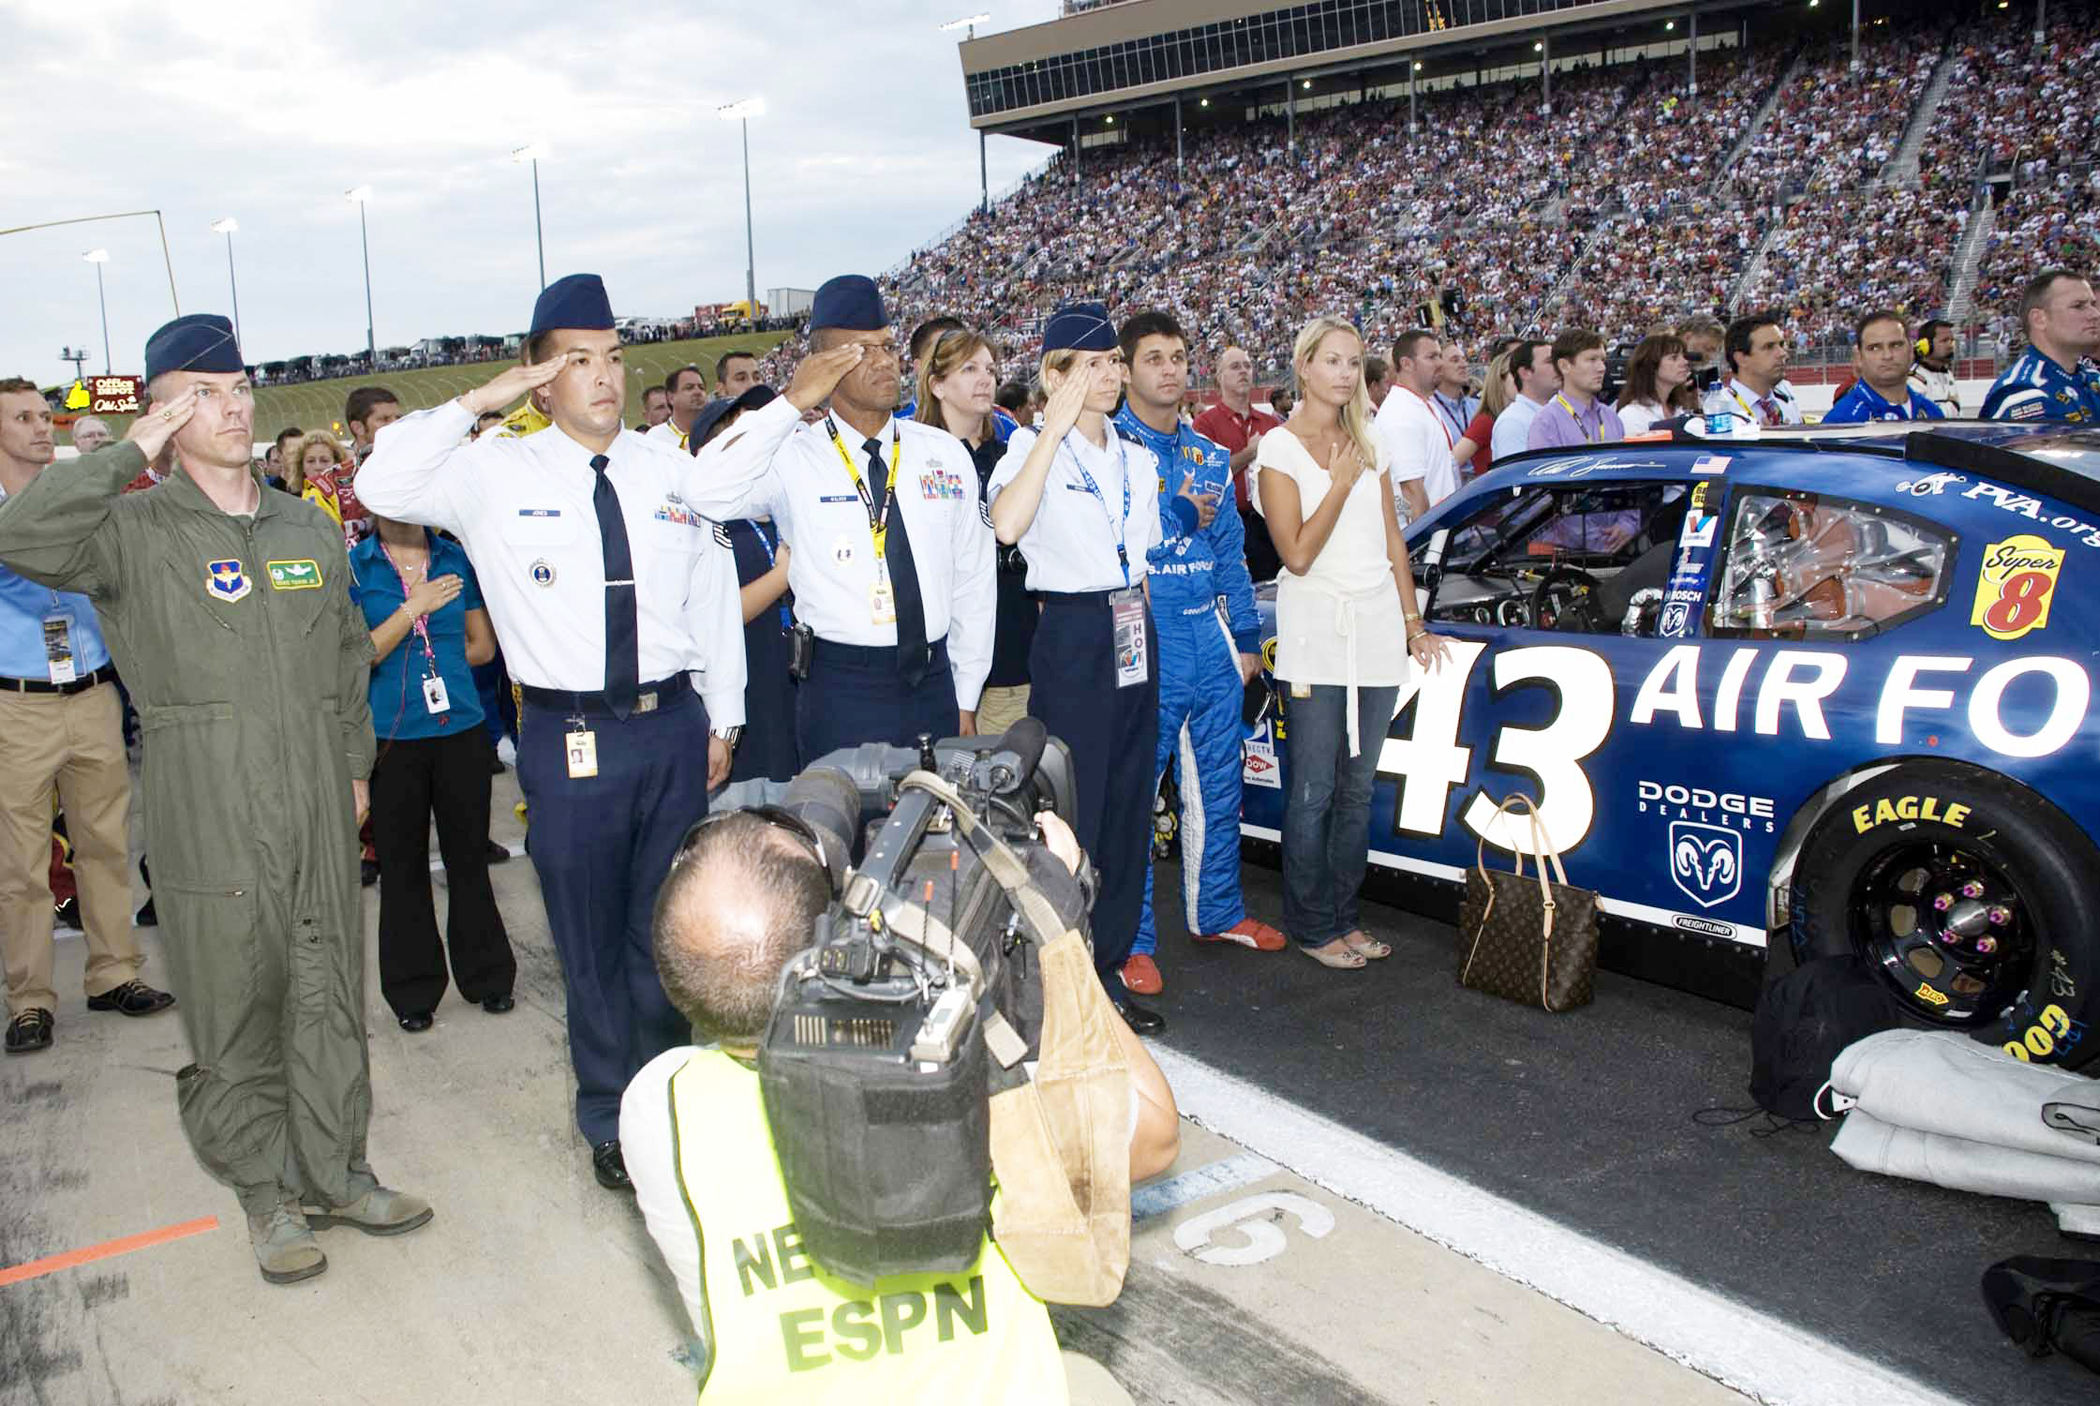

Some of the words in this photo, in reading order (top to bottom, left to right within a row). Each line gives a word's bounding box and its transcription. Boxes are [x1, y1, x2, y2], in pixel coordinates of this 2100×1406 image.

[97, 387, 135, 396] DEPOT
[1161, 563, 1188, 575] AIR
[1986, 546, 2059, 580] Super
[1671, 590, 1703, 602] BOSCH
[1983, 571, 2052, 633] 8
[1629, 644, 1849, 742] AIR
[1875, 654, 2092, 759] FO
[1376, 640, 1615, 857] 43
[1638, 780, 1775, 819] DODGE
[1639, 801, 1775, 834] DEALERS
[1852, 796, 1973, 835] EAGLE
[1677, 918, 1732, 937] FREIGHTLINER
[2002, 1004, 2070, 1063] GOO
[779, 1274, 988, 1373] ESPN
